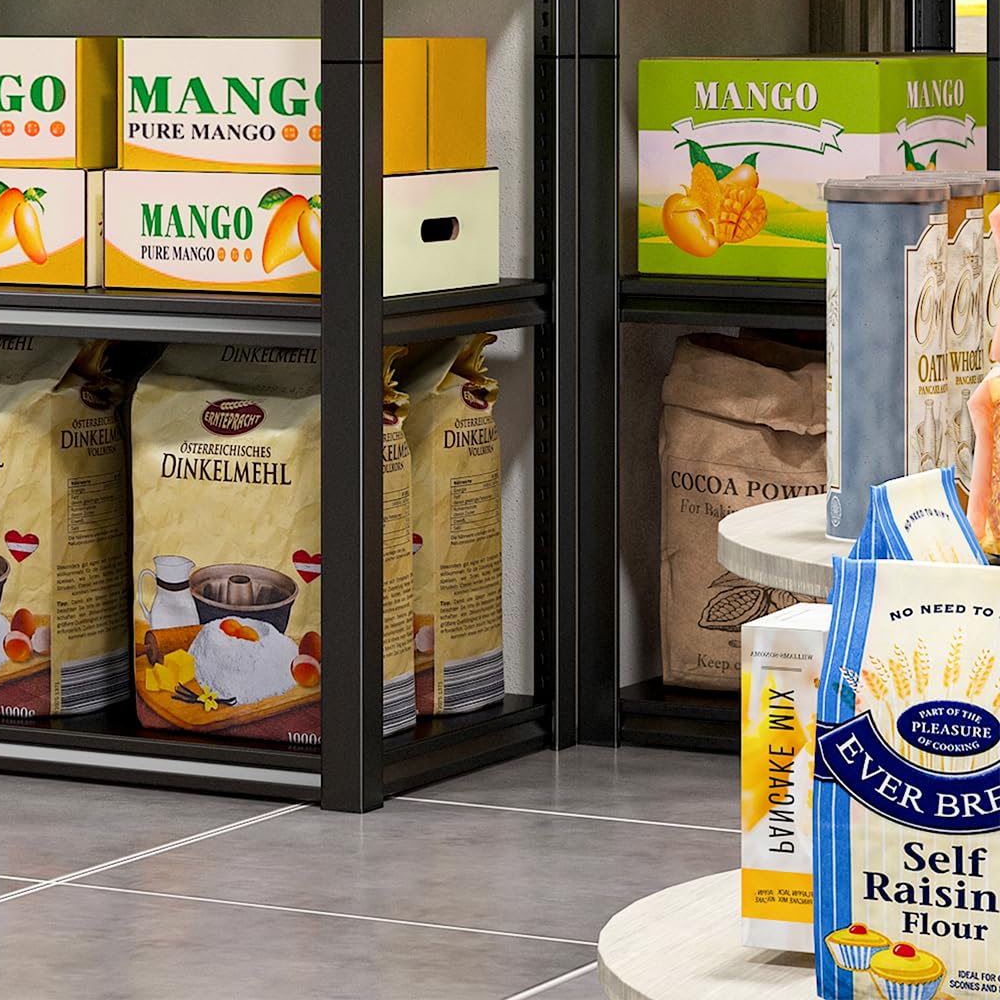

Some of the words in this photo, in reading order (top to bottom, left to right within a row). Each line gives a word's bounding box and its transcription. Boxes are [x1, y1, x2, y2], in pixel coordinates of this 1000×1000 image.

[128, 76, 321, 117] MANG
[694, 81, 818, 111] MANGO
[906, 79, 965, 109] MANGO
[128, 123, 185, 140] PURE
[191, 124, 276, 141] MANGO
[141, 203, 253, 240] MANGO
[141, 245, 169, 260] PURE
[172, 246, 215, 262] MANGO
[221, 344, 317, 364] DINKELMEHL
[204, 411, 261, 431] ERNTEPRACHT
[180, 440, 271, 458] ÖSTERREICHISCHES
[161, 452, 292, 485] DINKELMEHL
[671, 470, 739, 497] COCOA
[680, 498, 701, 513] For
[889, 607, 914, 621] NO
[920, 604, 966, 614] NEED
[972, 606, 994, 617] TO
[697, 654, 730, 673] Keep
[918, 708, 945, 720] PART
[946, 707, 960, 717] OF
[961, 709, 983, 724] THE
[911, 721, 992, 739] PLEASURE
[917, 736, 932, 747] OF
[932, 740, 981, 752] COOKING
[835, 732, 924, 814] EVER
[903, 841, 988, 878] Self
[902, 911, 988, 941] Flour
[958, 970, 979, 981] IDEAL
[981, 972, 995, 983] FOR
[949, 980, 981, 992] SCONES
[981, 983, 997, 993] AND
